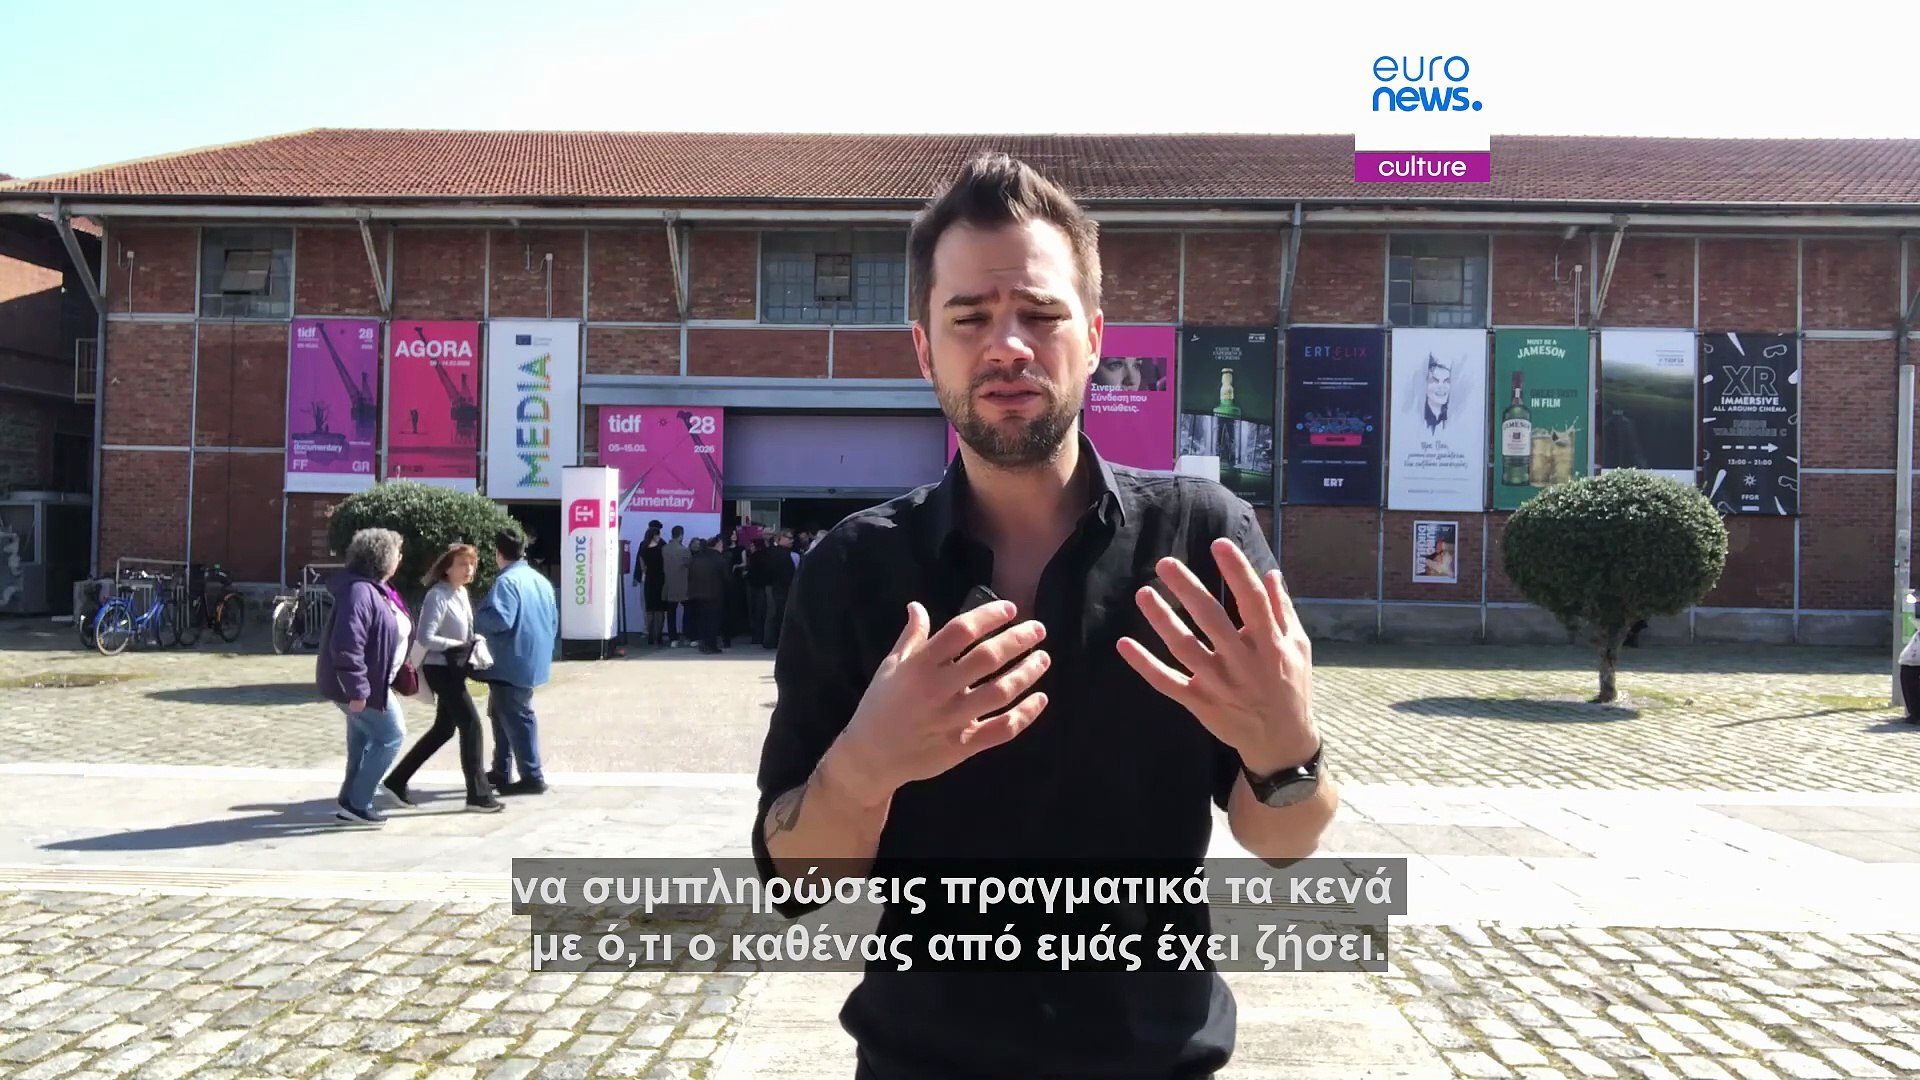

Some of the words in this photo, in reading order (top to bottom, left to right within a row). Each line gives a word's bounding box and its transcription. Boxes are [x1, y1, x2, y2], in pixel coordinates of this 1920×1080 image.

[297, 327, 317, 338] tidf
[358, 328, 374, 340] 28
[394, 340, 473, 358] AGORA
[1517, 345, 1567, 359] JAMESON
[1721, 365, 1779, 396] XR
[1090, 393, 1129, 403] Σύνδεση
[1130, 394, 1148, 402] που
[1531, 397, 1540, 408] IN
[1541, 397, 1561, 408] FILM
[1721, 396, 1780, 406] IMMERSIVE
[1090, 404, 1101, 414] τη
[1727, 405, 1758, 413] AROUND
[1758, 405, 1788, 413] CINEMA
[515, 352, 552, 489] MEDIA
[607, 414, 642, 433] tidf
[688, 415, 716, 435] 28
[693, 445, 715, 454] 2026
[292, 459, 309, 471] FF
[352, 460, 371, 472] GR
[1323, 478, 1345, 487] ERT
